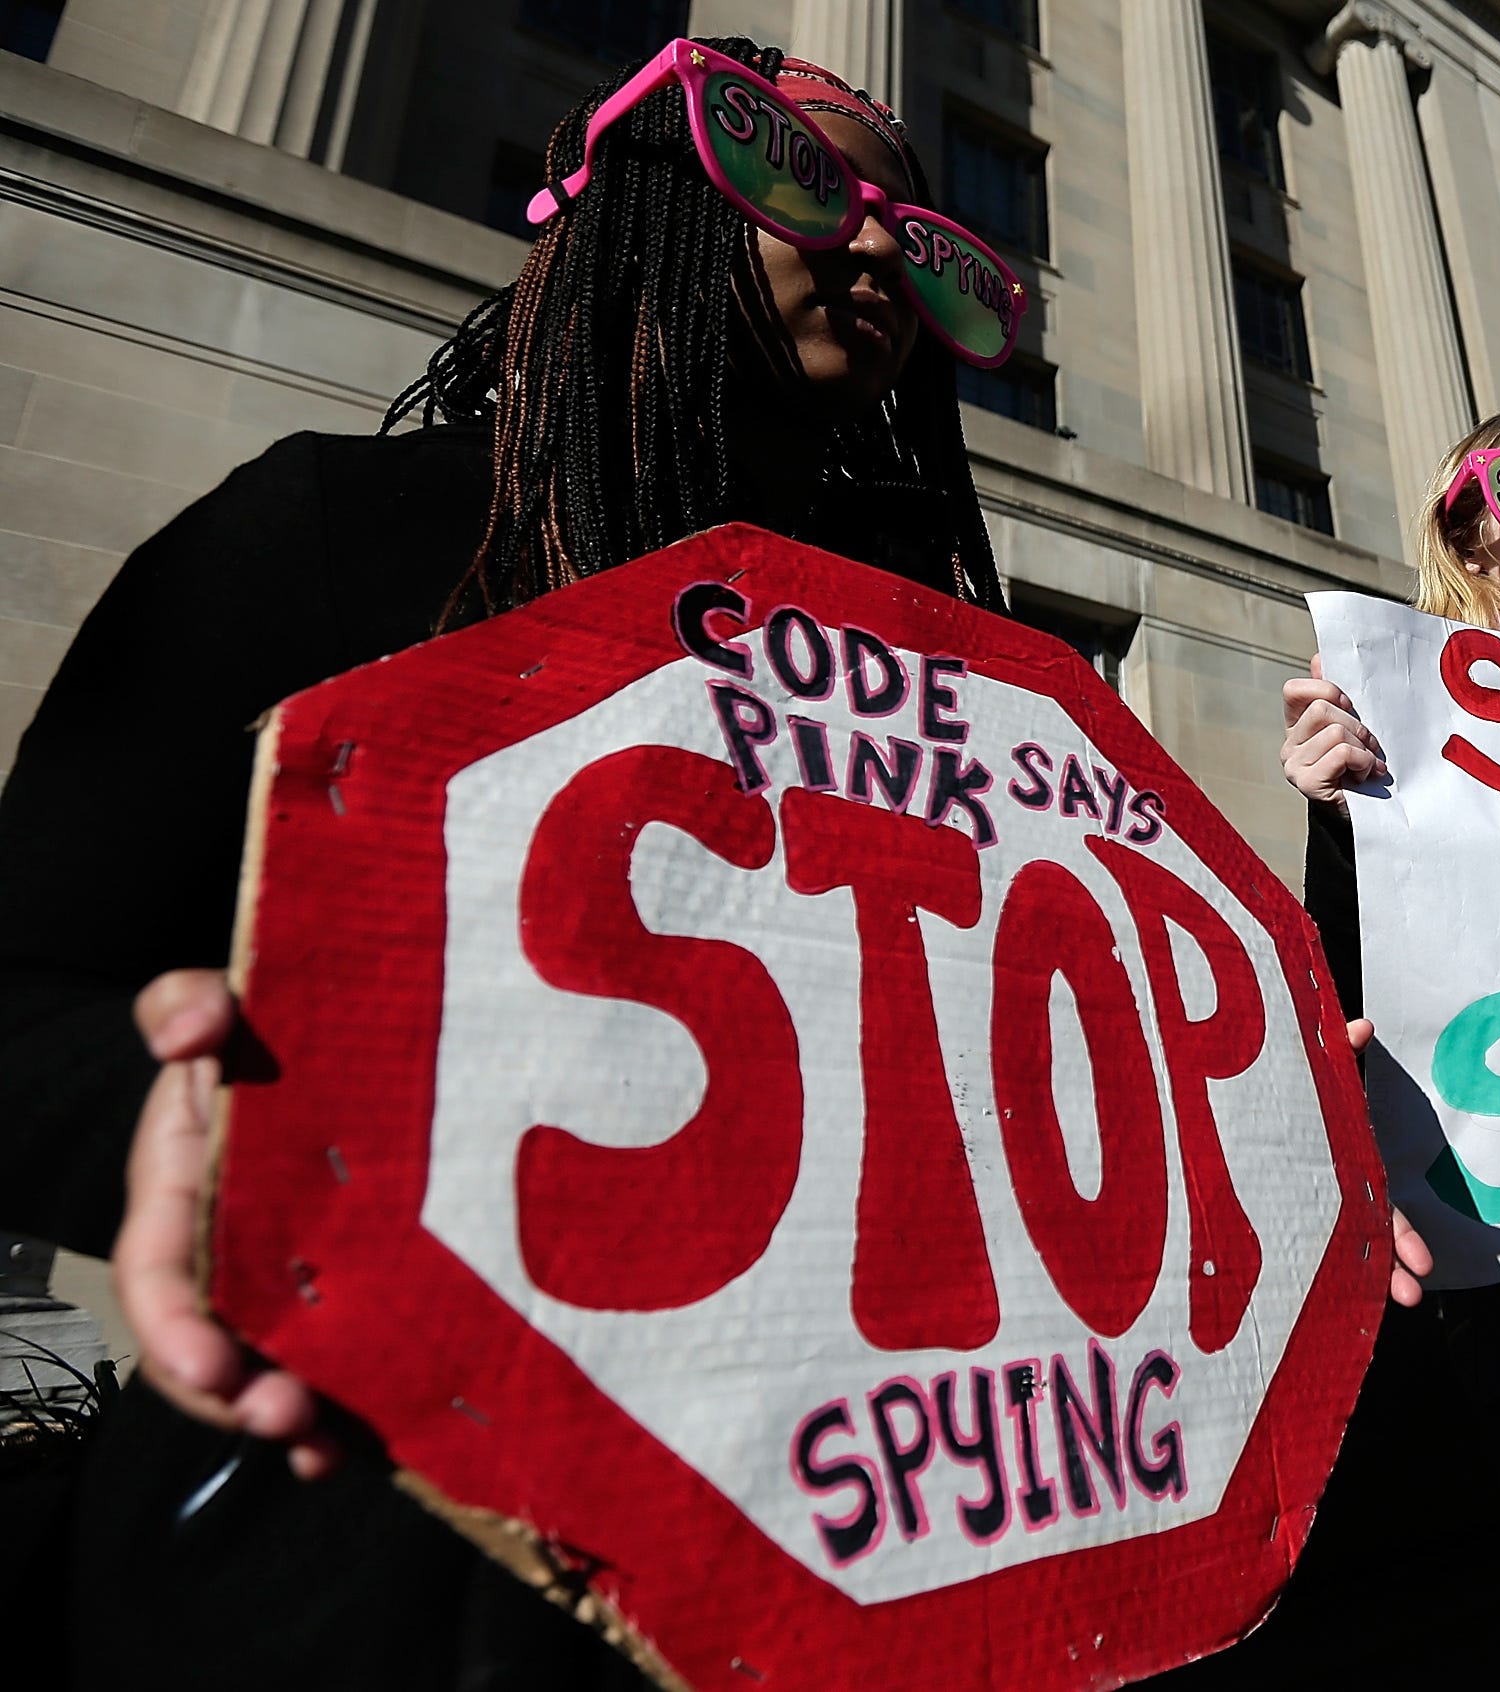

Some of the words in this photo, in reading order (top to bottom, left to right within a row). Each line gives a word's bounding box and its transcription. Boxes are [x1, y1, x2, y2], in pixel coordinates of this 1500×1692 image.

[711, 81, 840, 204] STOP
[903, 218, 1012, 338] SPYING
[672, 580, 968, 744] CODE
[706, 678, 999, 850] PINK
[1008, 741, 1167, 845] SAYS
[515, 744, 1266, 1356] STOP
[791, 1338, 1188, 1568] SPYING
